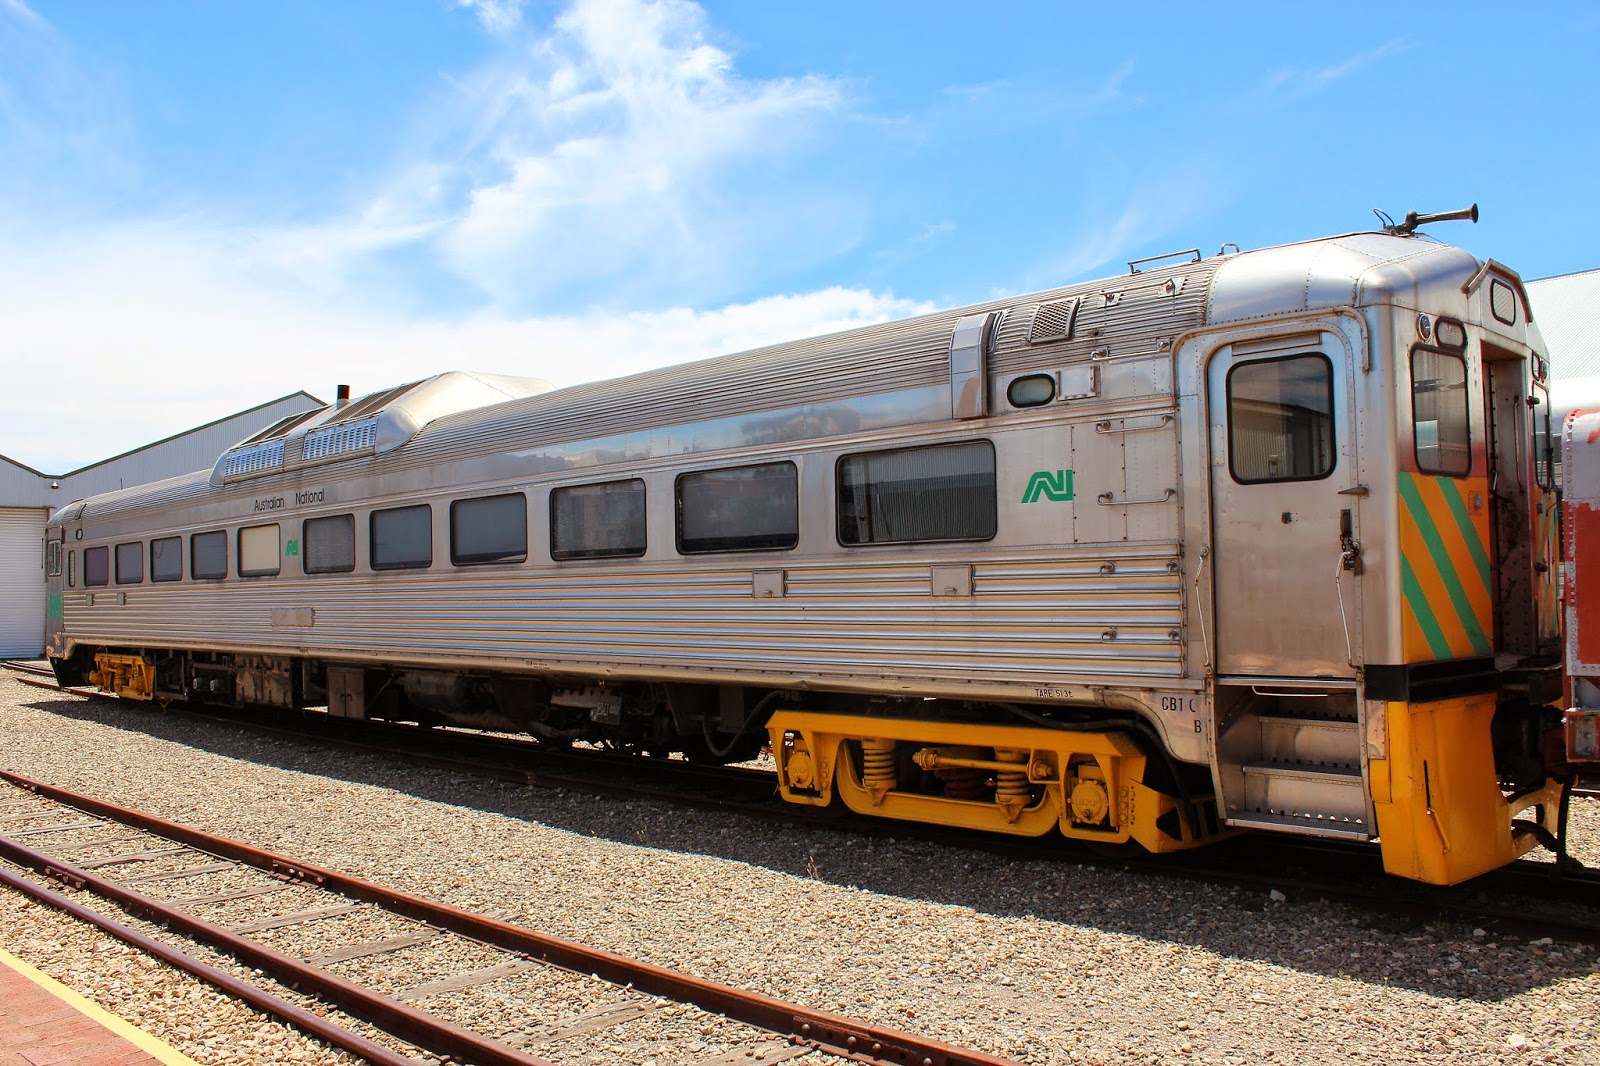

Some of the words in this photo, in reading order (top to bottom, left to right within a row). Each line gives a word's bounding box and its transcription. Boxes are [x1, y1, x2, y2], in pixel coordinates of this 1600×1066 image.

[254, 496, 285, 512] Australian
[295, 488, 325, 506] National
[1035, 688, 1053, 698] TARE
[1162, 697, 1182, 712] CB1
[1194, 720, 1202, 733] B
